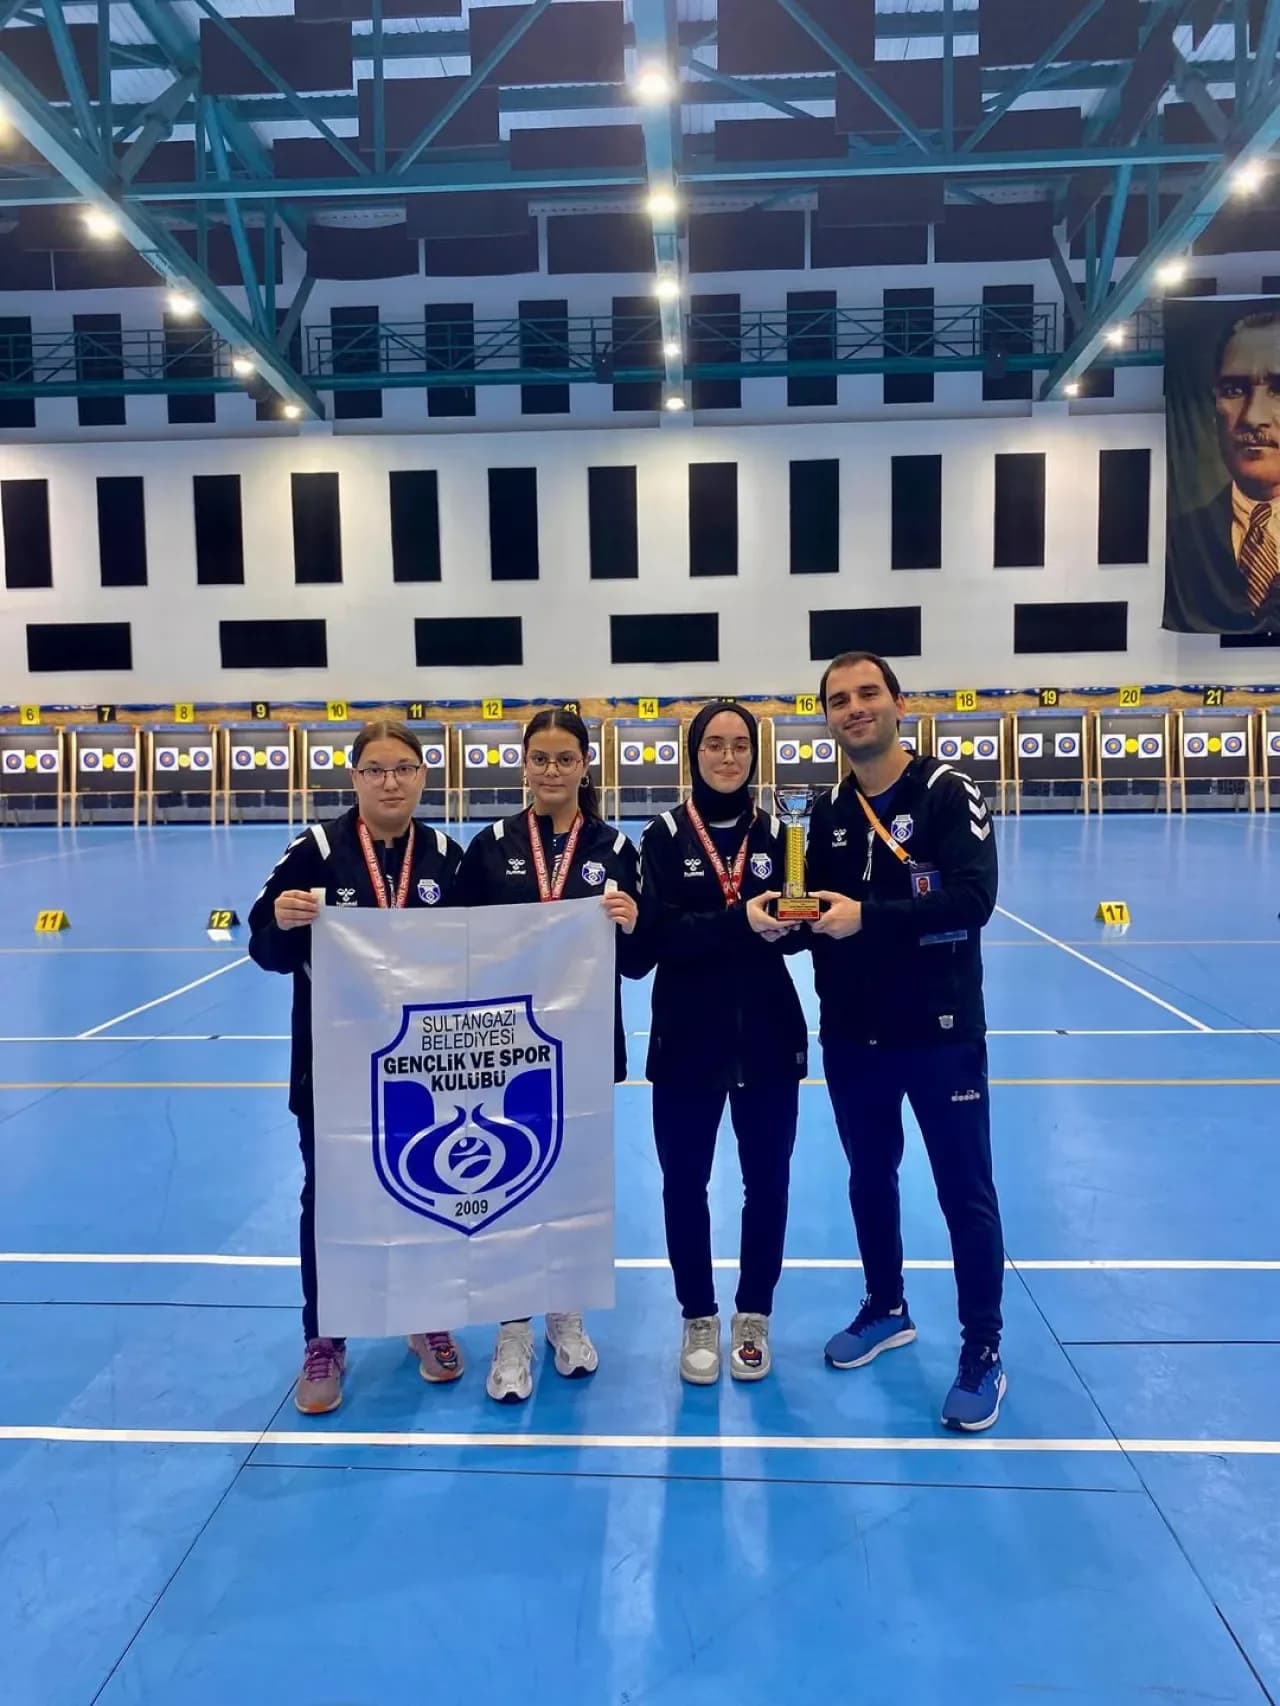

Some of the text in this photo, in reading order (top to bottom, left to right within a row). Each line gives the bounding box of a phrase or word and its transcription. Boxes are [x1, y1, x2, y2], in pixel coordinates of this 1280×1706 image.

[959, 693, 974, 707] 18
[1042, 690, 1056, 705] 19
[1123, 690, 1138, 703] 20
[1206, 689, 1222, 705] 21
[256, 704, 266, 718] 9
[331, 704, 344, 718] 10
[410, 704, 423, 718] 11
[486, 703, 499, 716] 12
[643, 702, 654, 714] 14
[800, 698, 814, 711] 16
[26, 708, 34, 721] 6
[102, 707, 111, 721] 7
[180, 706, 188, 719] 8
[210, 911, 232, 929] 12
[1106, 905, 1125, 921] 17
[40, 912, 59, 929] 11
[470, 1051, 495, 1069] VE
[500, 1045, 551, 1067] SPOR
[431, 1070, 506, 1093] KULÜBÜ
[455, 1199, 489, 1217] 2009
